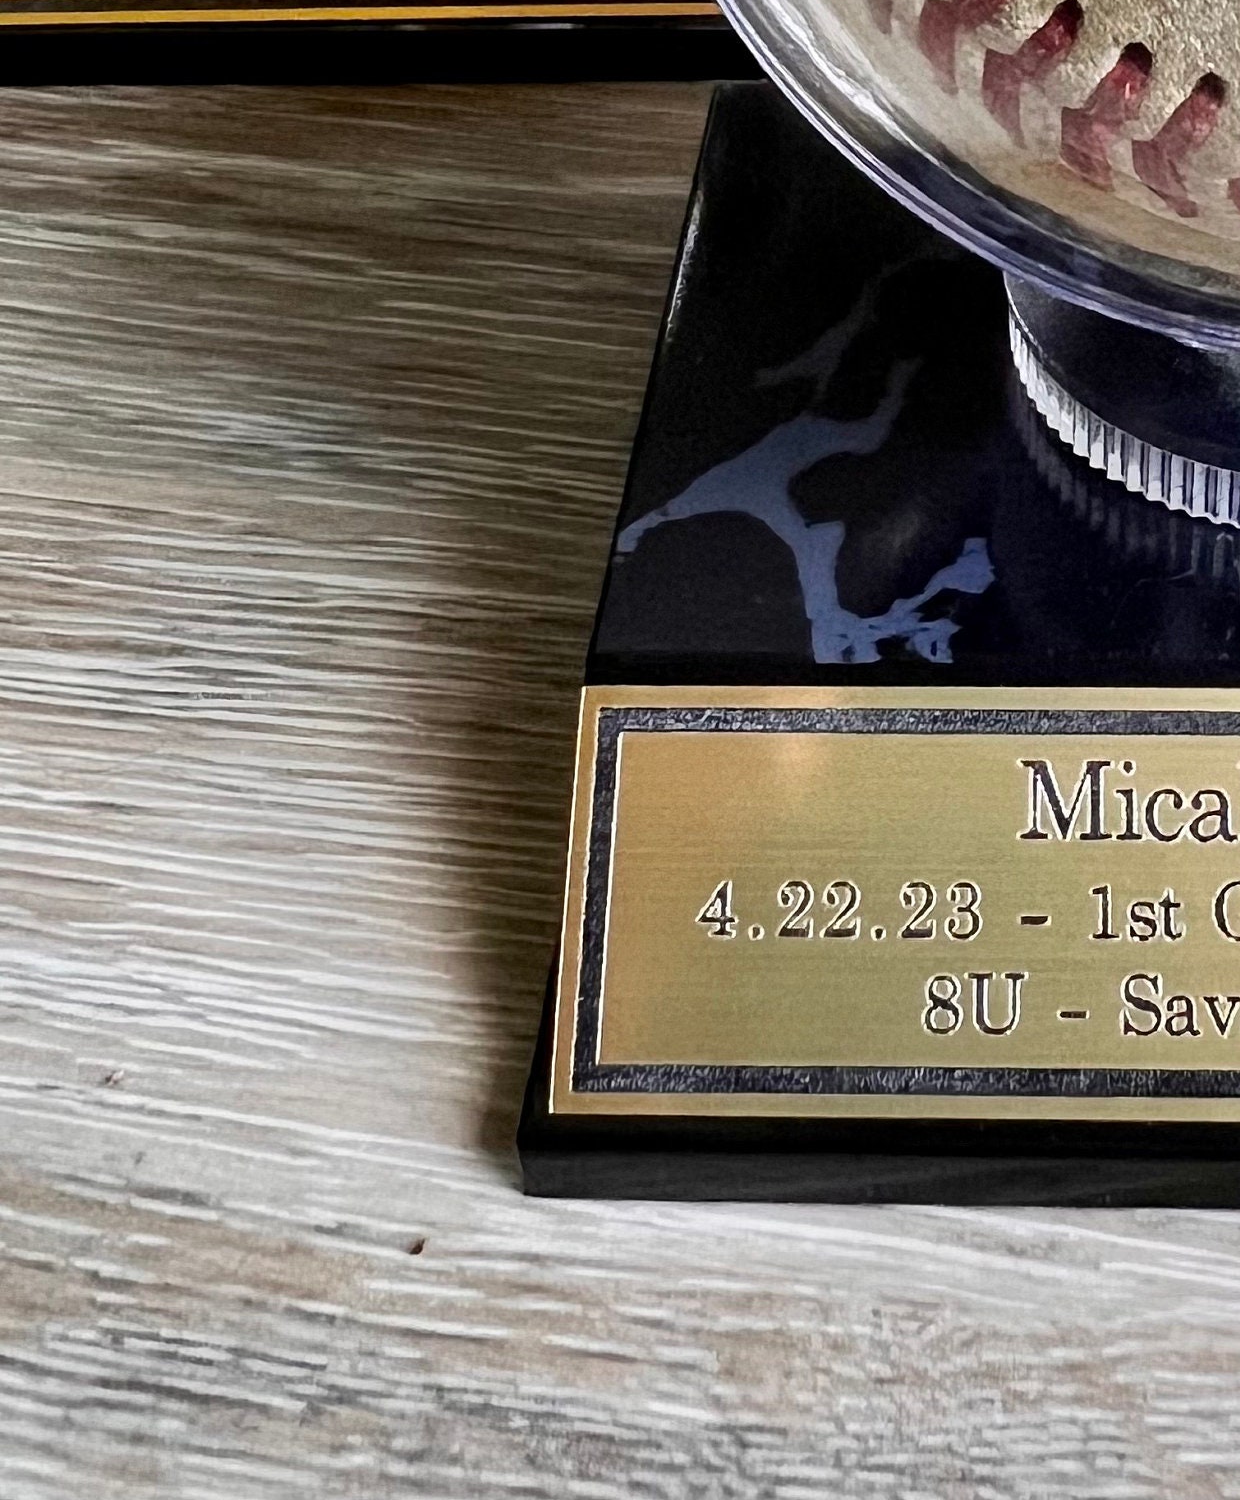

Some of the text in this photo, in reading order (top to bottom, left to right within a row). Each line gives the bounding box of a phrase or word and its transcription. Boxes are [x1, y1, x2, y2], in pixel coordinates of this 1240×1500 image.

[697, 880, 983, 940] 4.22.23
[1090, 884, 1181, 940] 1st
[921, 972, 1028, 1036] 8U
